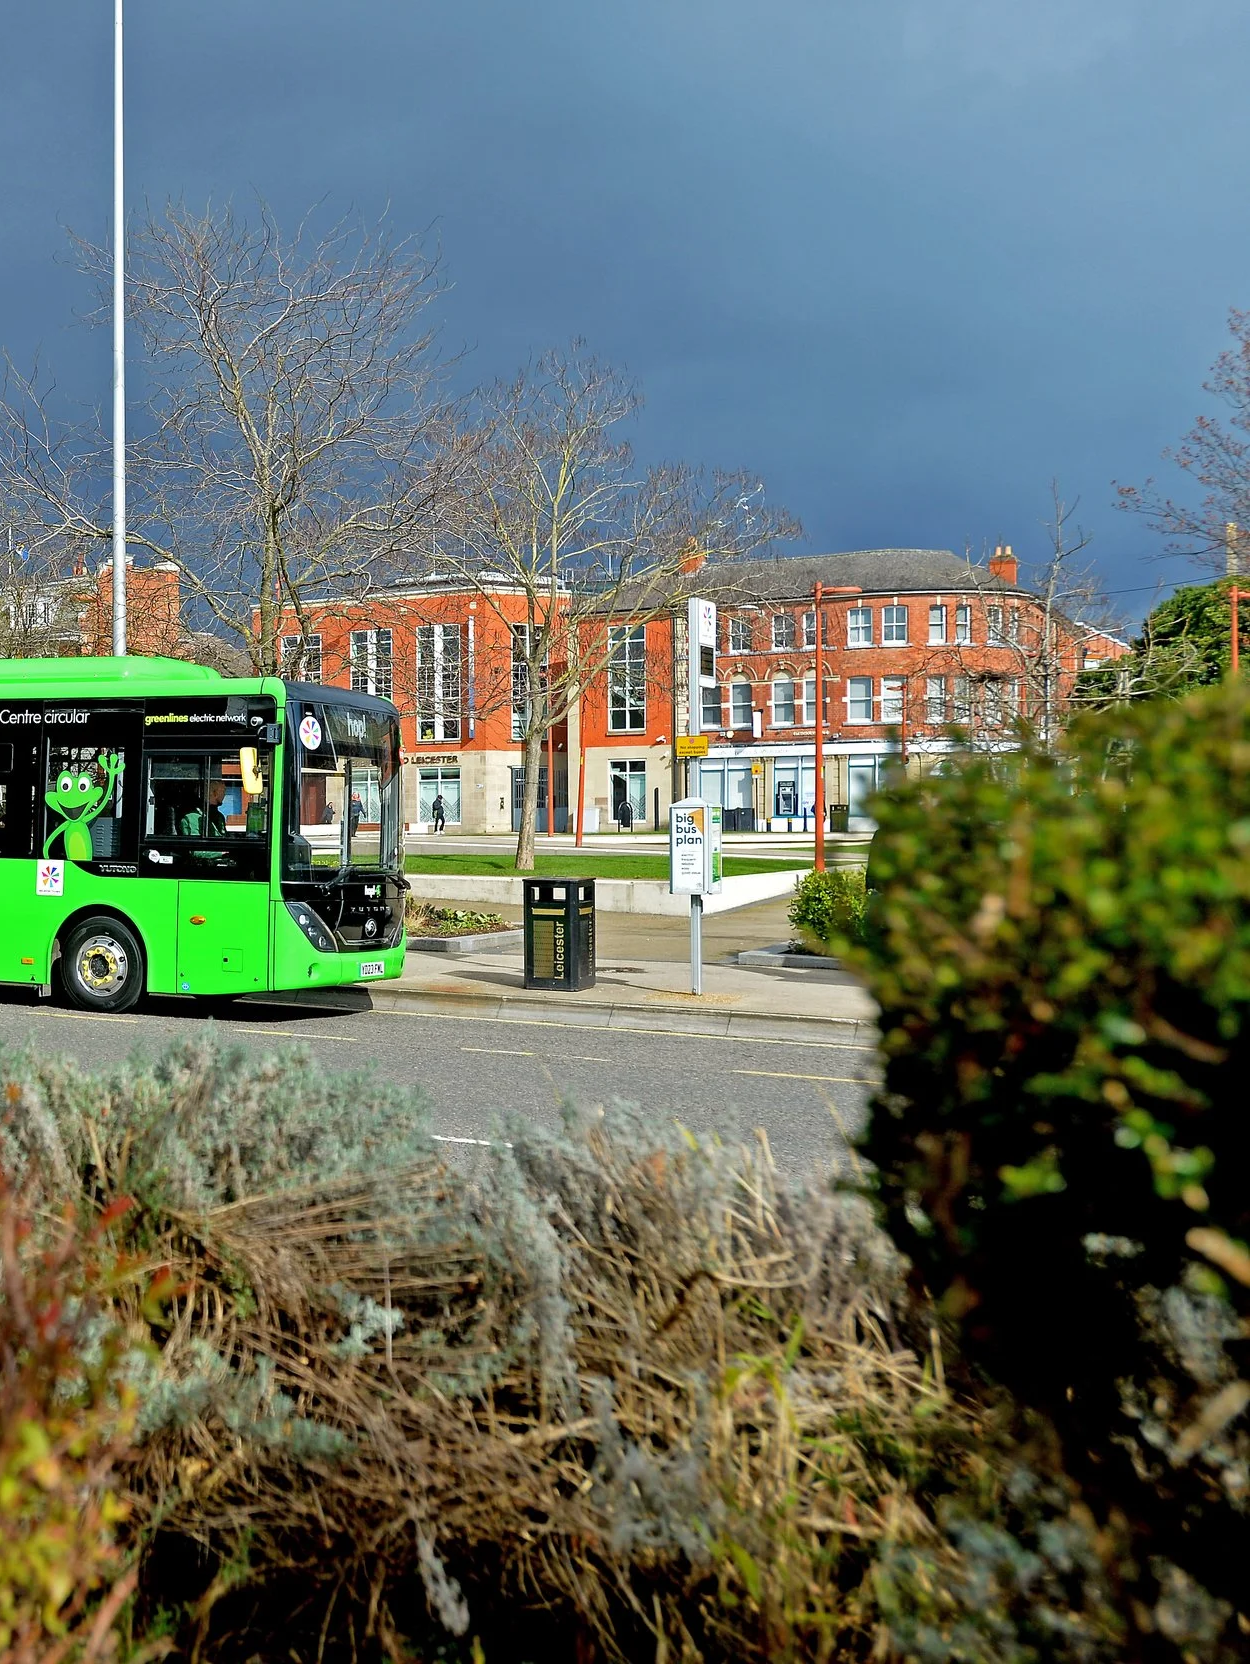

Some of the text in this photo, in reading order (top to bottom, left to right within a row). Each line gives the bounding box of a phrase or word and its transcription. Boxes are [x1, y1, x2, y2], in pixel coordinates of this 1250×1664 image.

[0, 709, 42, 724] Centre
[44, 708, 90, 724] circular
[145, 712, 247, 726] greenlines electric network
[411, 755, 459, 765] LEICESTER
[675, 813, 694, 825] big
[675, 824, 697, 834] bus
[676, 835, 702, 847] plan
[554, 921, 565, 980] Leicester
